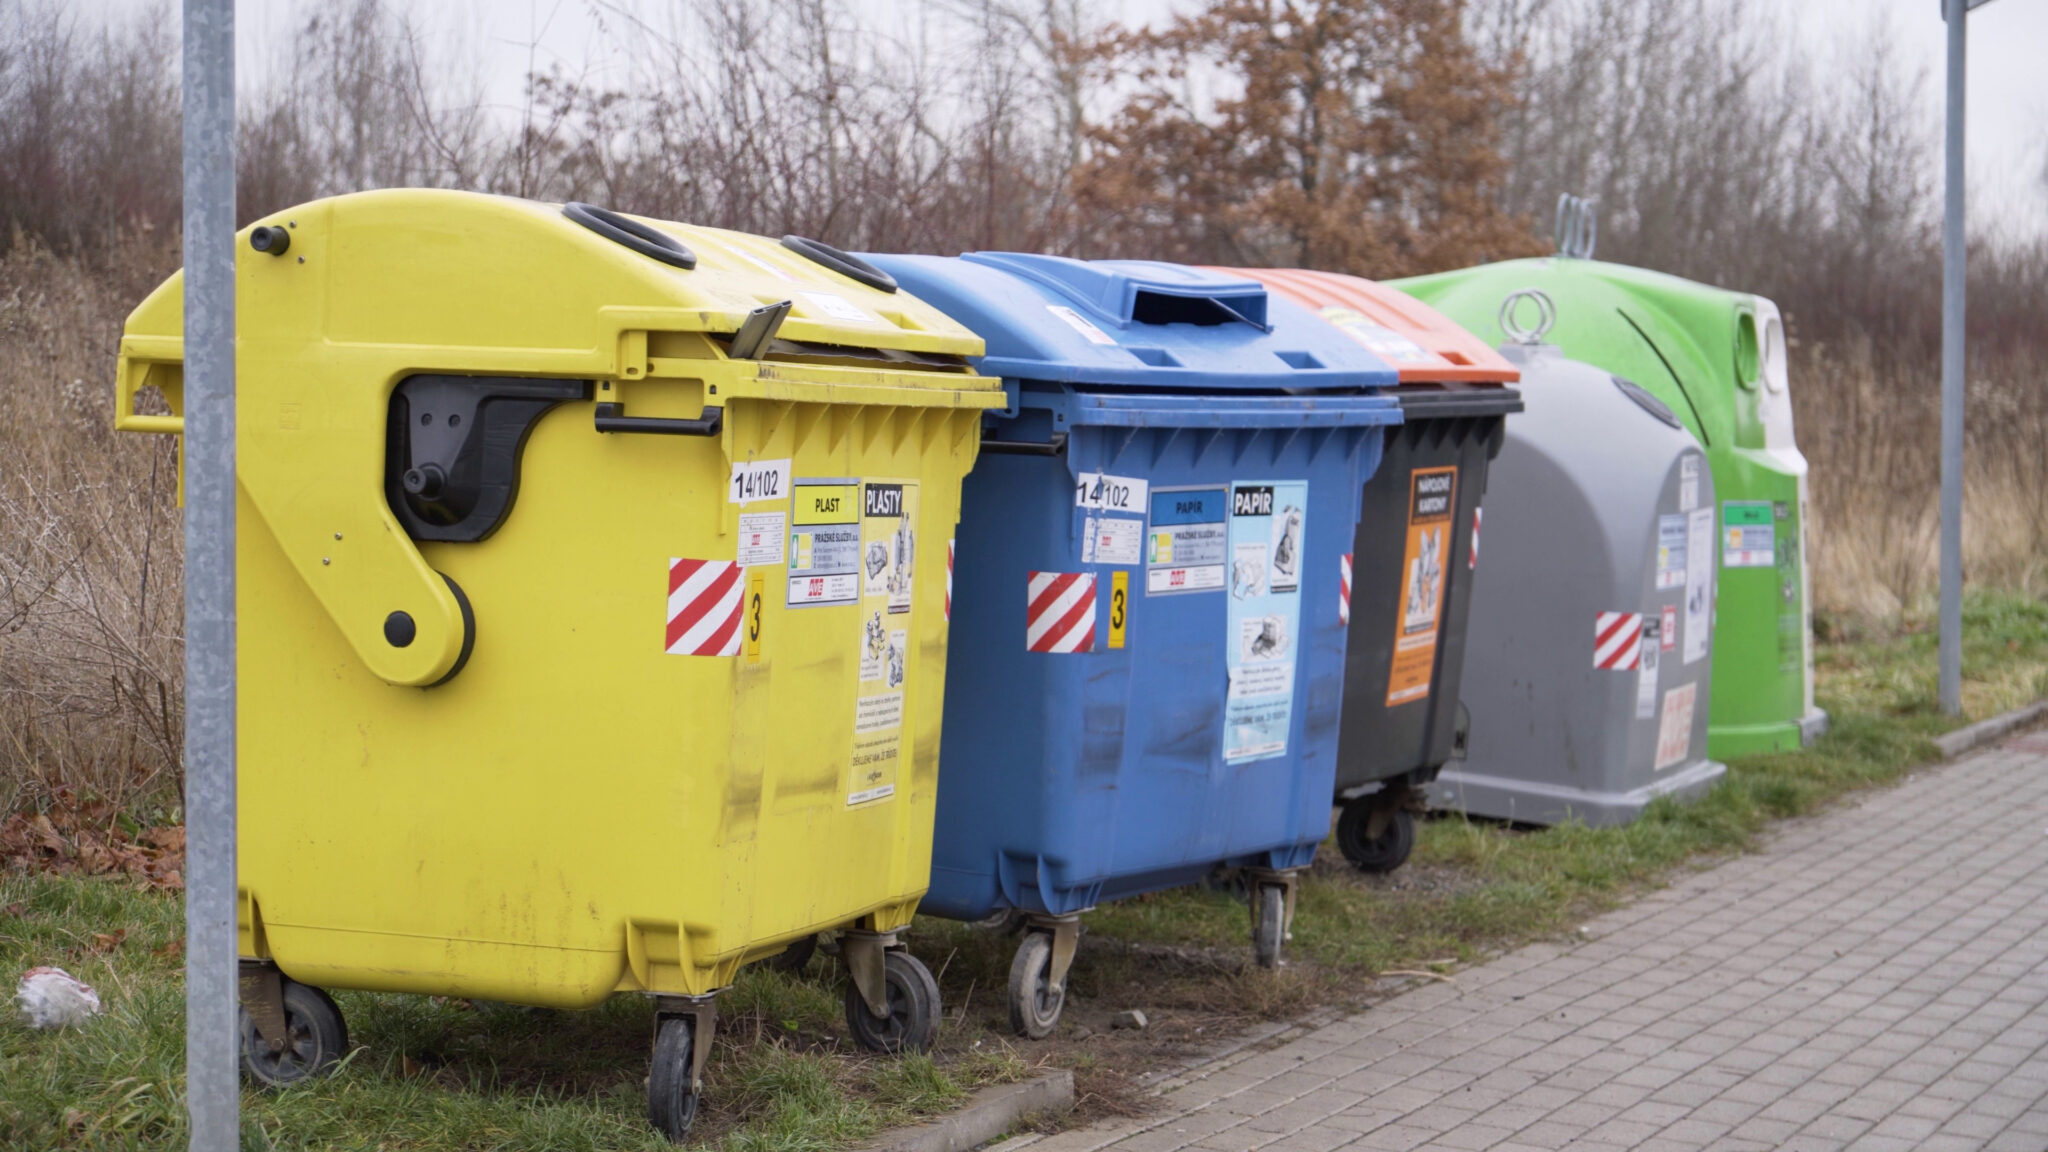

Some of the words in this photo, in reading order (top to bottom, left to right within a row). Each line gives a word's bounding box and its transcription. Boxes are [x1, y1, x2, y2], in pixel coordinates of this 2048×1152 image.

[735, 470, 778, 498] 14/102
[815, 498, 840, 513] PLAST
[866, 489, 901, 514] PLASTY
[1176, 501, 1203, 514] PAPÍR
[1235, 487, 1272, 514] PAPÍR
[751, 593, 761, 642] 3
[1112, 589, 1124, 629] 3
